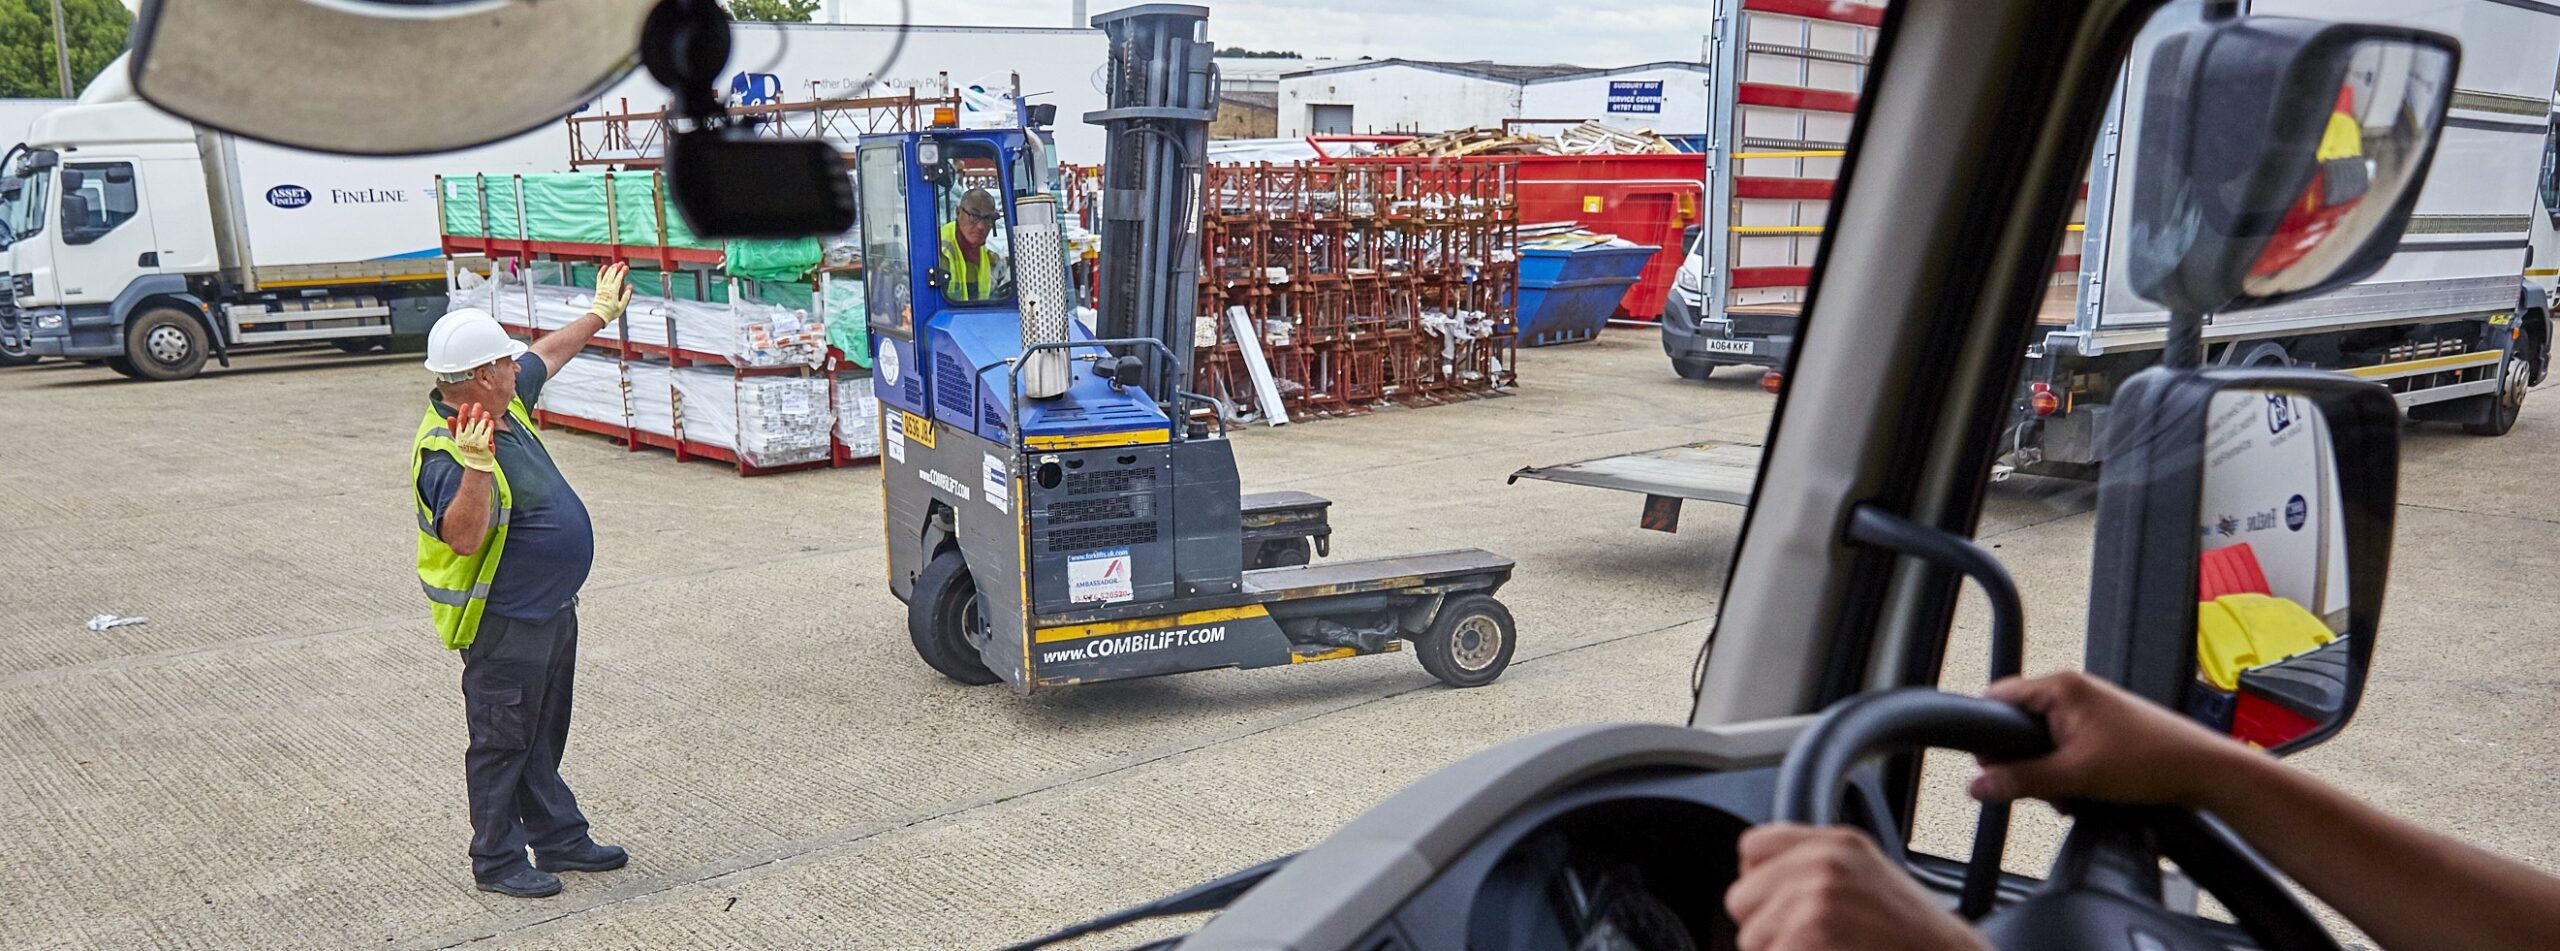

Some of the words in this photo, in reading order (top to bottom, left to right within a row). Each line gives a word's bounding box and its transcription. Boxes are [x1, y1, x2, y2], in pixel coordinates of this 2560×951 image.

[803, 78, 840, 89] Ather
[272, 188, 306, 197] ASSET
[1732, 342, 1750, 351] KKF
[1076, 578, 1119, 588] AMBASSADOR
[1044, 626, 1226, 663] www.COMBiLiFT.COM
